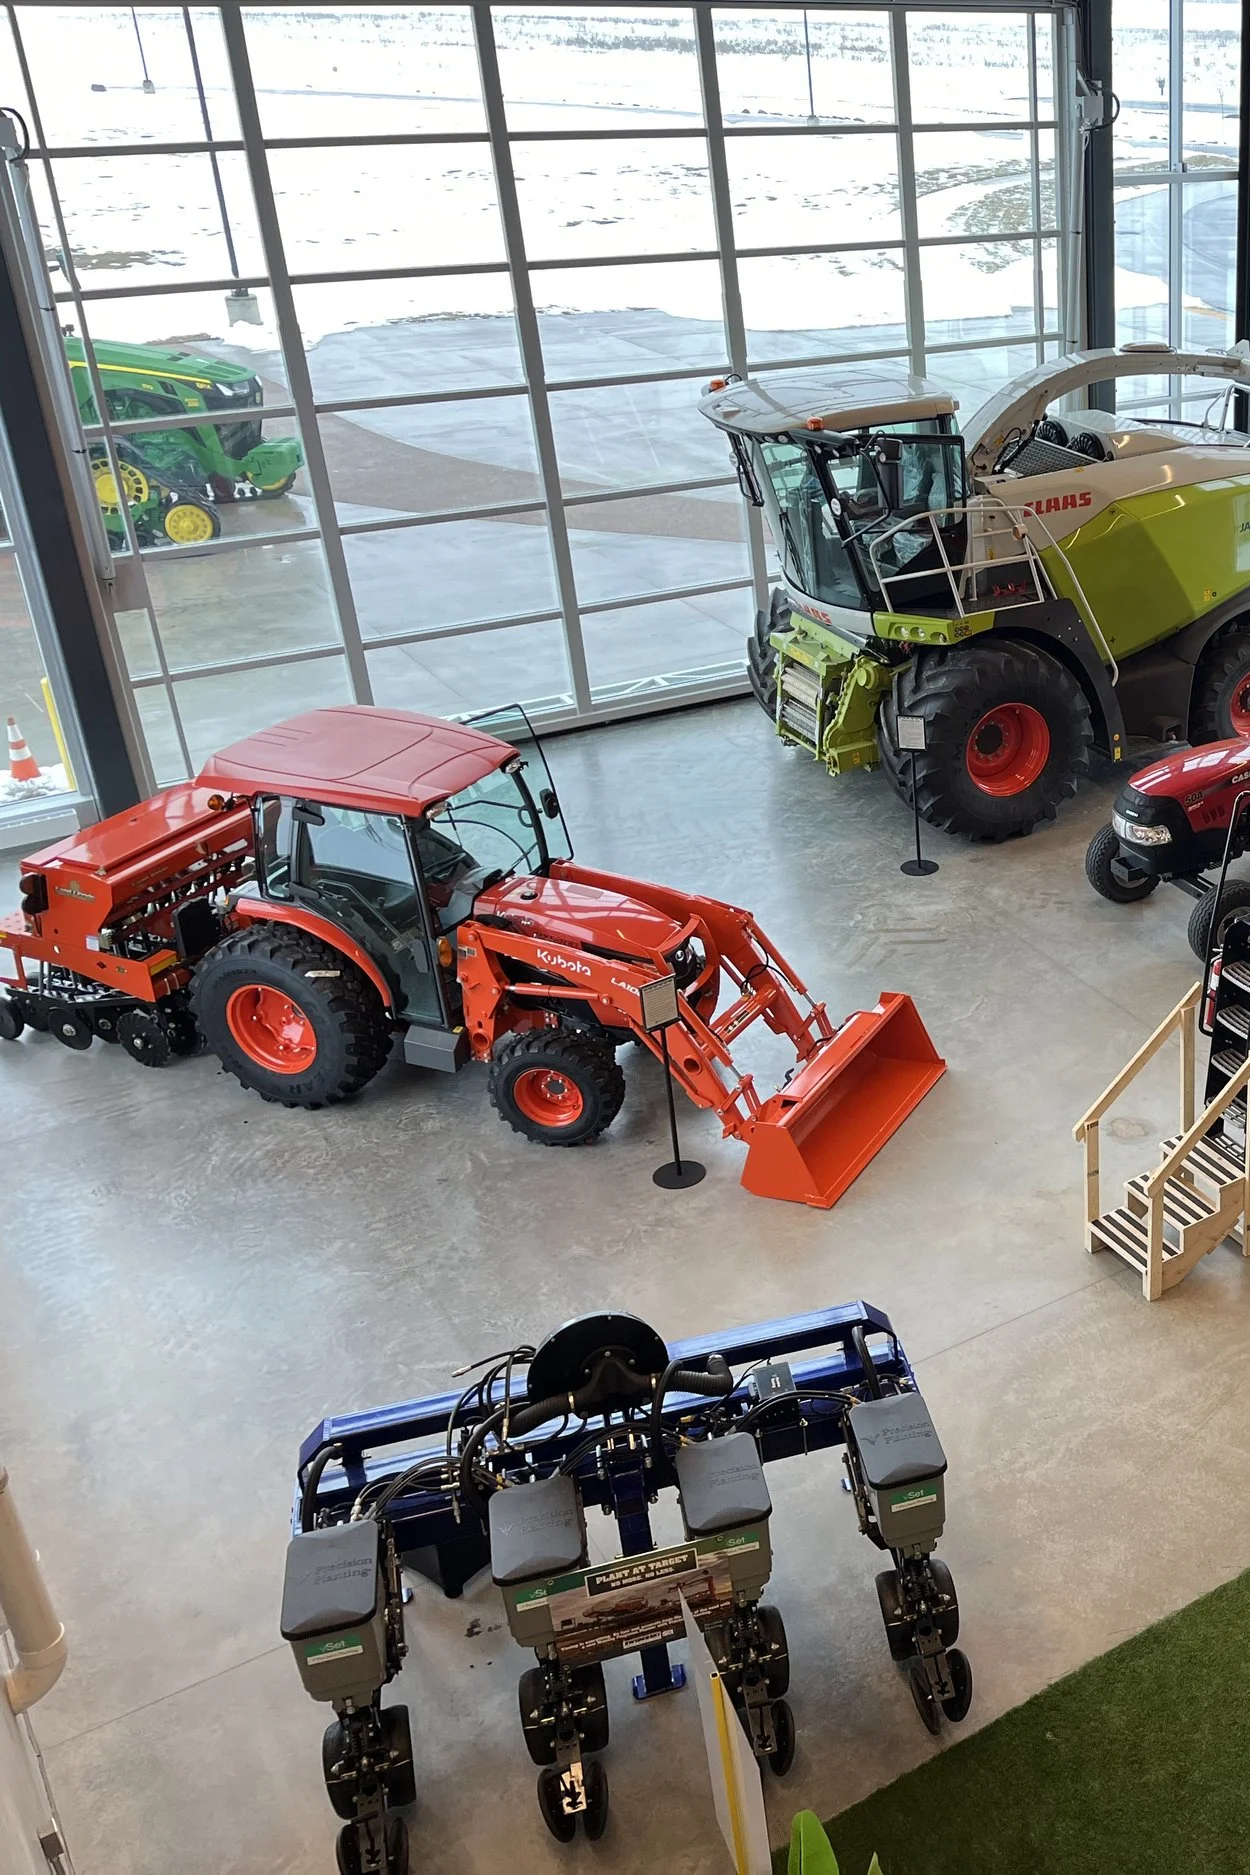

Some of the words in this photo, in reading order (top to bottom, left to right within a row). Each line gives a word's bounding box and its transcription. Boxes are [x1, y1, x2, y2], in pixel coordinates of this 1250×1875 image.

[1024, 492, 1092, 517] CLAAS
[1185, 791, 1204, 806] 50A
[536, 948, 592, 977] Kubota
[610, 977, 641, 997] LA10
[727, 1536, 746, 1546] Set
[595, 1569, 630, 1585] PLANT
[632, 1565, 647, 1575] AT
[648, 1554, 689, 1570] TARGET
